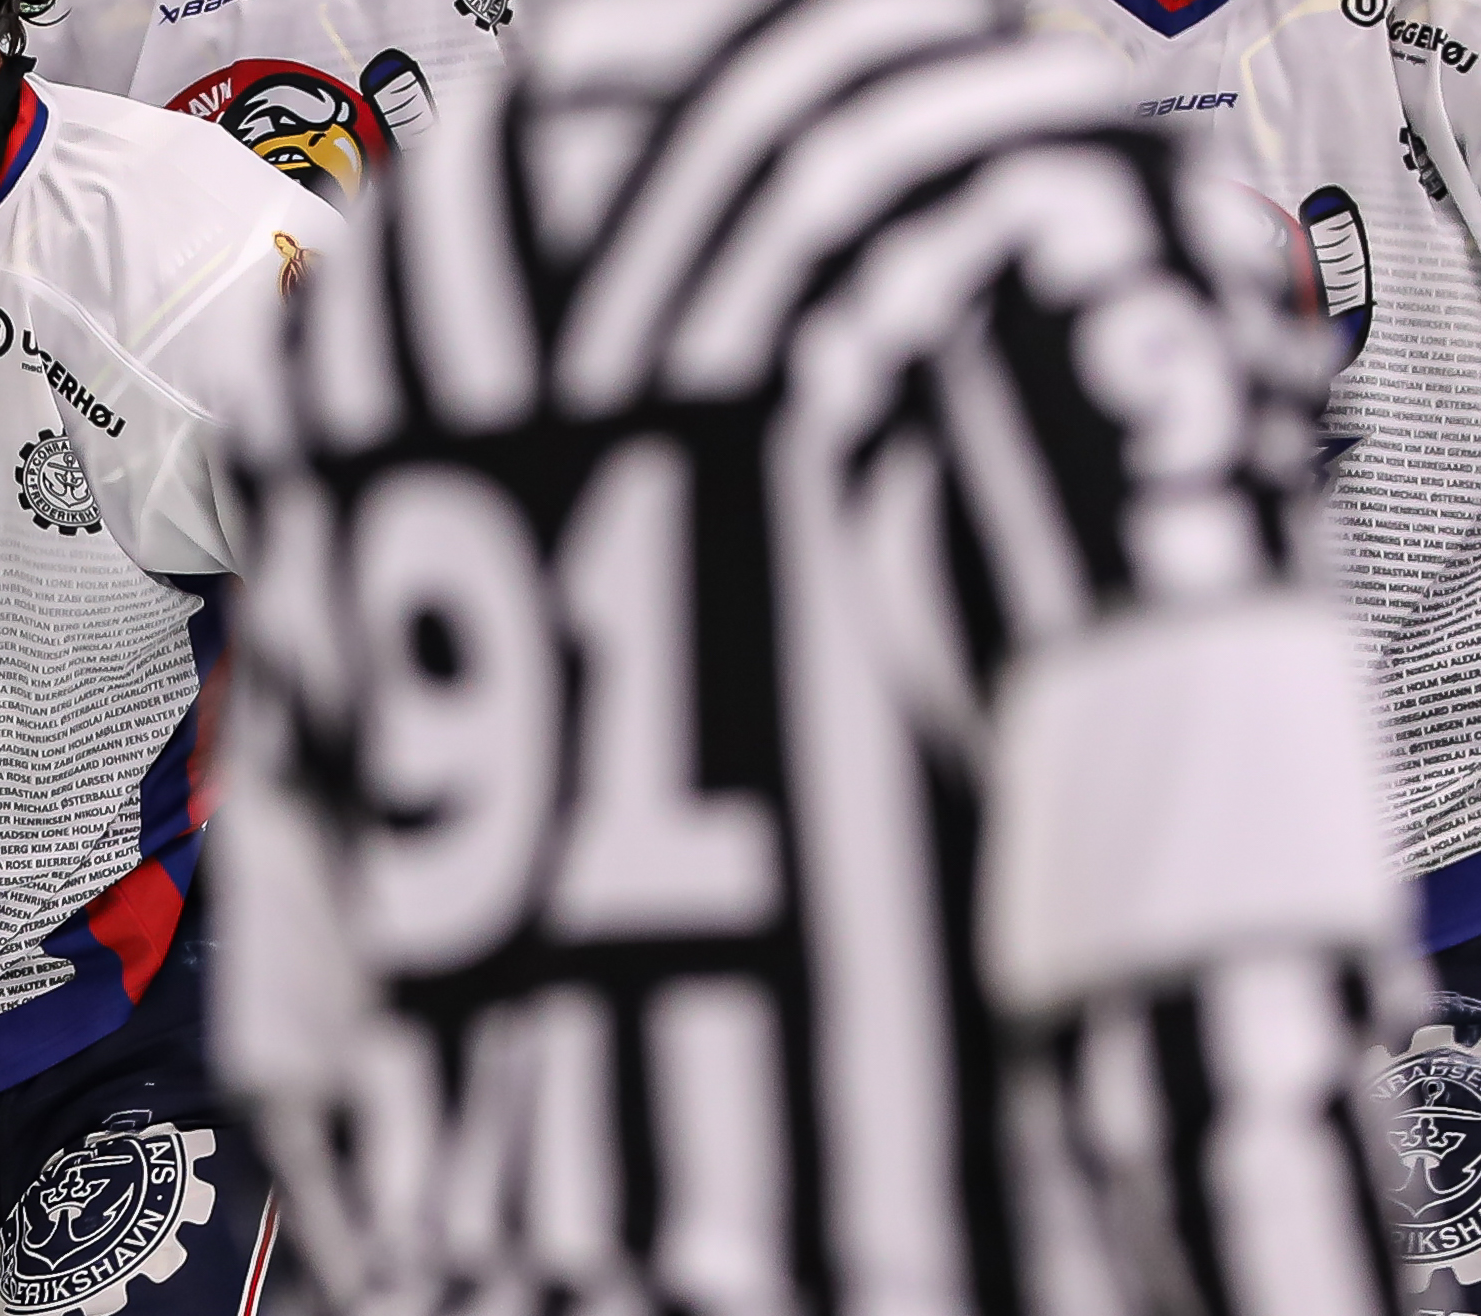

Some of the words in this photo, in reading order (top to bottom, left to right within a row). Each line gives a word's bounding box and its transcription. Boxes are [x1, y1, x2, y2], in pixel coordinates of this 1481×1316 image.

[22, 328, 126, 438] UERHØJ
[28, 484, 101, 523] FREDERIKSHA
[349, 432, 791, 974] 91
[101, 748, 144, 768] JOHNNY
[75, 774, 115, 789] LARSEN
[13, 801, 59, 814] MICHAEL
[73, 804, 116, 821] NIKOLAJ
[72, 823, 104, 836] HOLM
[30, 843, 52, 854] KIM
[5, 858, 33, 870] ROSE
[35, 855, 82, 869] BJERREGA
[4, 1209, 165, 1306] ERIKSHAVN
